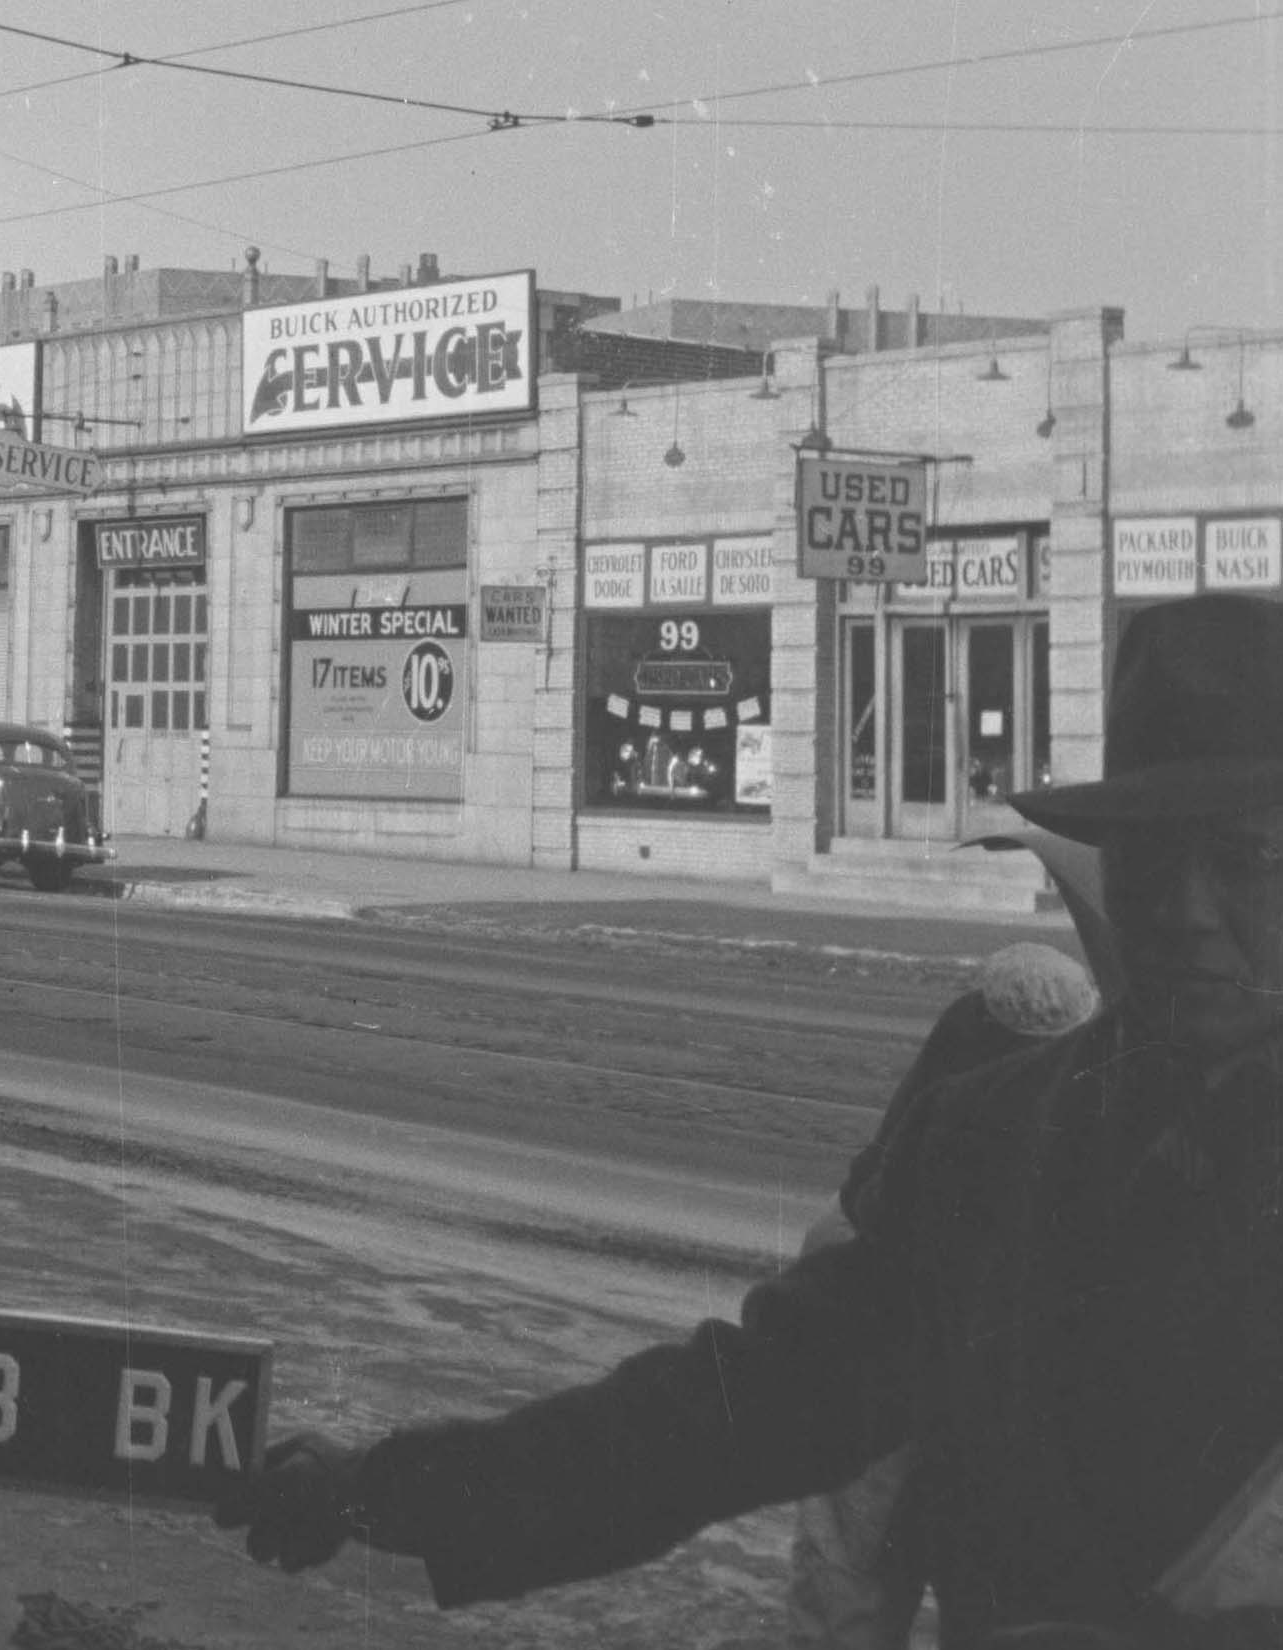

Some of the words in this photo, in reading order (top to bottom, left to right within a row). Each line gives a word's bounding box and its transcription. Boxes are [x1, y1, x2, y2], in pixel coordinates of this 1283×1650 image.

[270, 309, 338, 340] BUICK
[347, 289, 499, 332] AUTHORIZED
[262, 320, 507, 417] SERVICE
[820, 471, 910, 506] USED
[807, 506, 923, 555] CARS
[1118, 528, 1194, 552] PACKARD
[1216, 526, 1268, 550] BUICK
[100, 525, 199, 562] ENTRANCE
[587, 553, 643, 575] CHEVROLET
[660, 550, 698, 572] FORD
[846, 556, 886, 577] 99
[962, 549, 1017, 586] CARS
[1117, 559, 1195, 582] PLYMOUTH
[1216, 556, 1270, 580] NASH
[594, 579, 633, 599] DODGE
[720, 574, 735, 595] DE
[739, 574, 771, 594] SOTO
[309, 613, 372, 636] WINTER
[380, 610, 460, 635] SPECIAL
[485, 606, 542, 625] WANTED
[659, 619, 700, 651] 99
[312, 658, 333, 689] 17
[333, 665, 387, 689] ITEMS
[113, 1367, 249, 1472] BK
